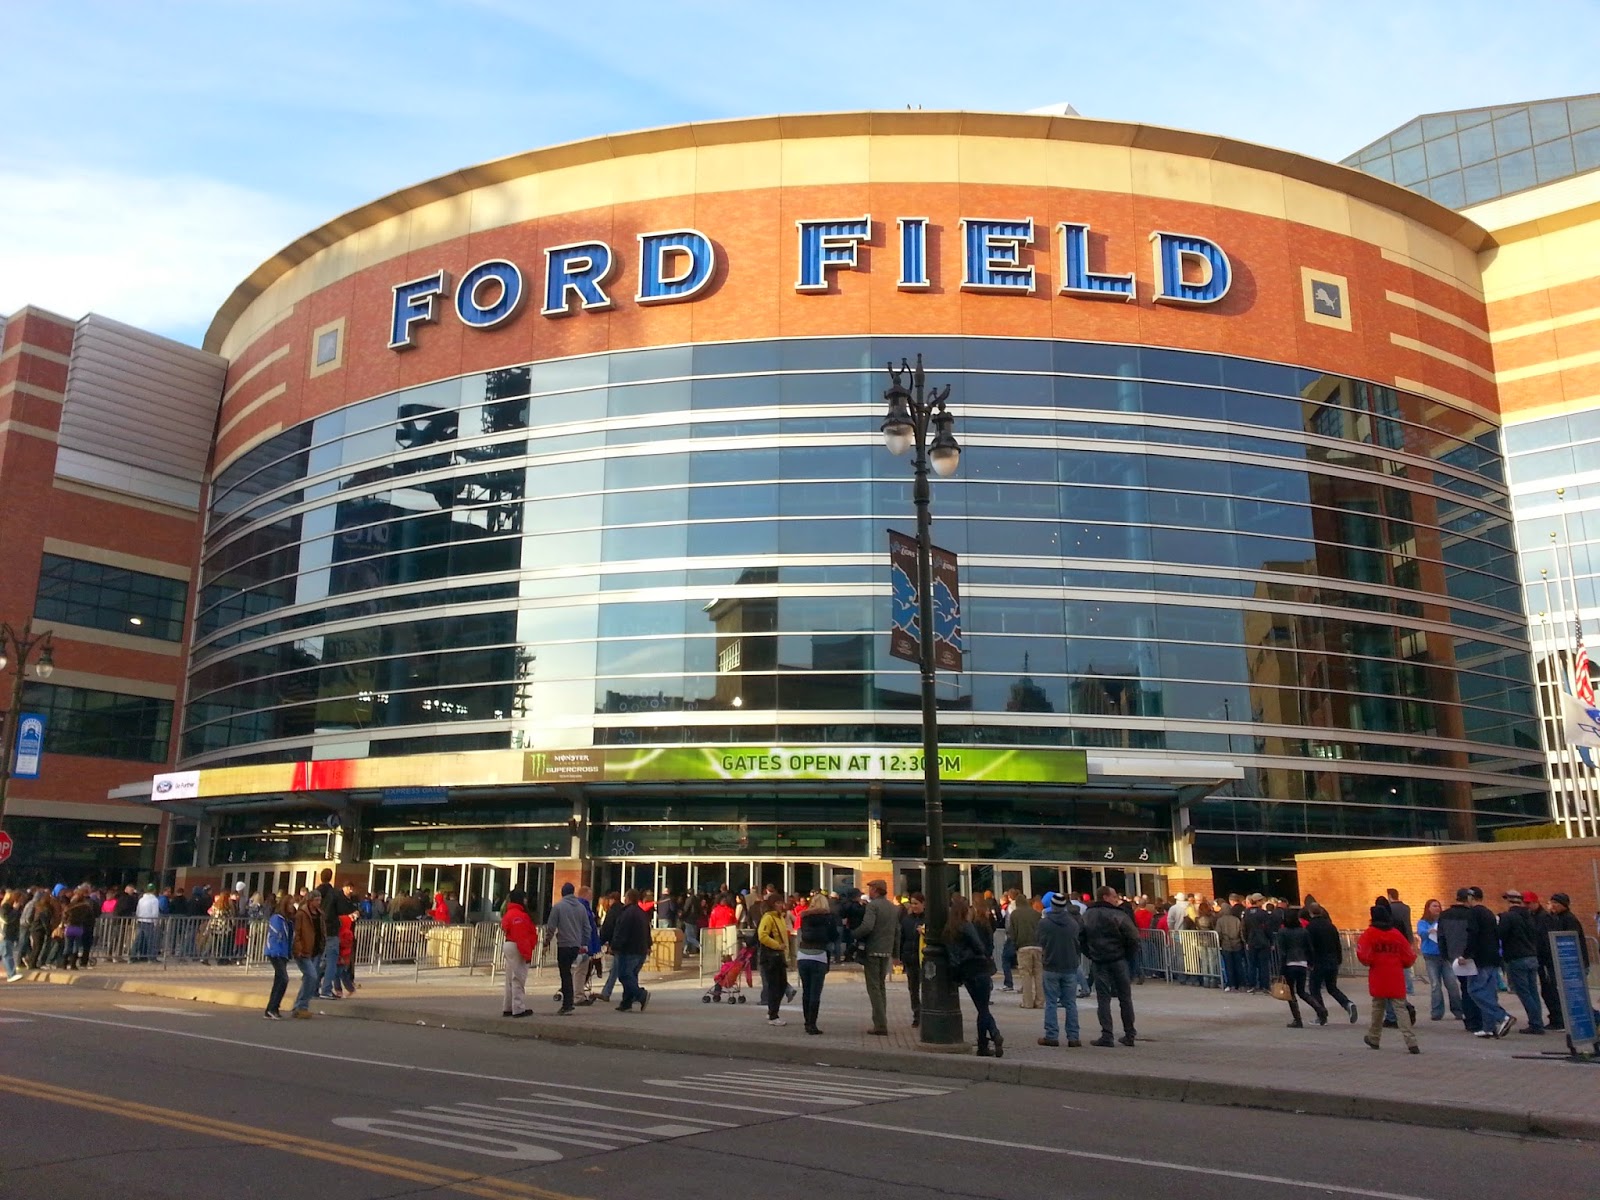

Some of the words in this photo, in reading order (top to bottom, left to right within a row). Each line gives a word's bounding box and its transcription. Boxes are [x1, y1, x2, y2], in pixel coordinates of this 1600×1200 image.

[387, 229, 717, 352] FORD
[794, 213, 1234, 307] FIELD
[554, 754, 590, 762] MONSTER
[722, 755, 782, 771] GATES
[789, 755, 841, 771] OPEN
[848, 755, 871, 771] AT
[385, 787, 420, 795] EXPRESS
